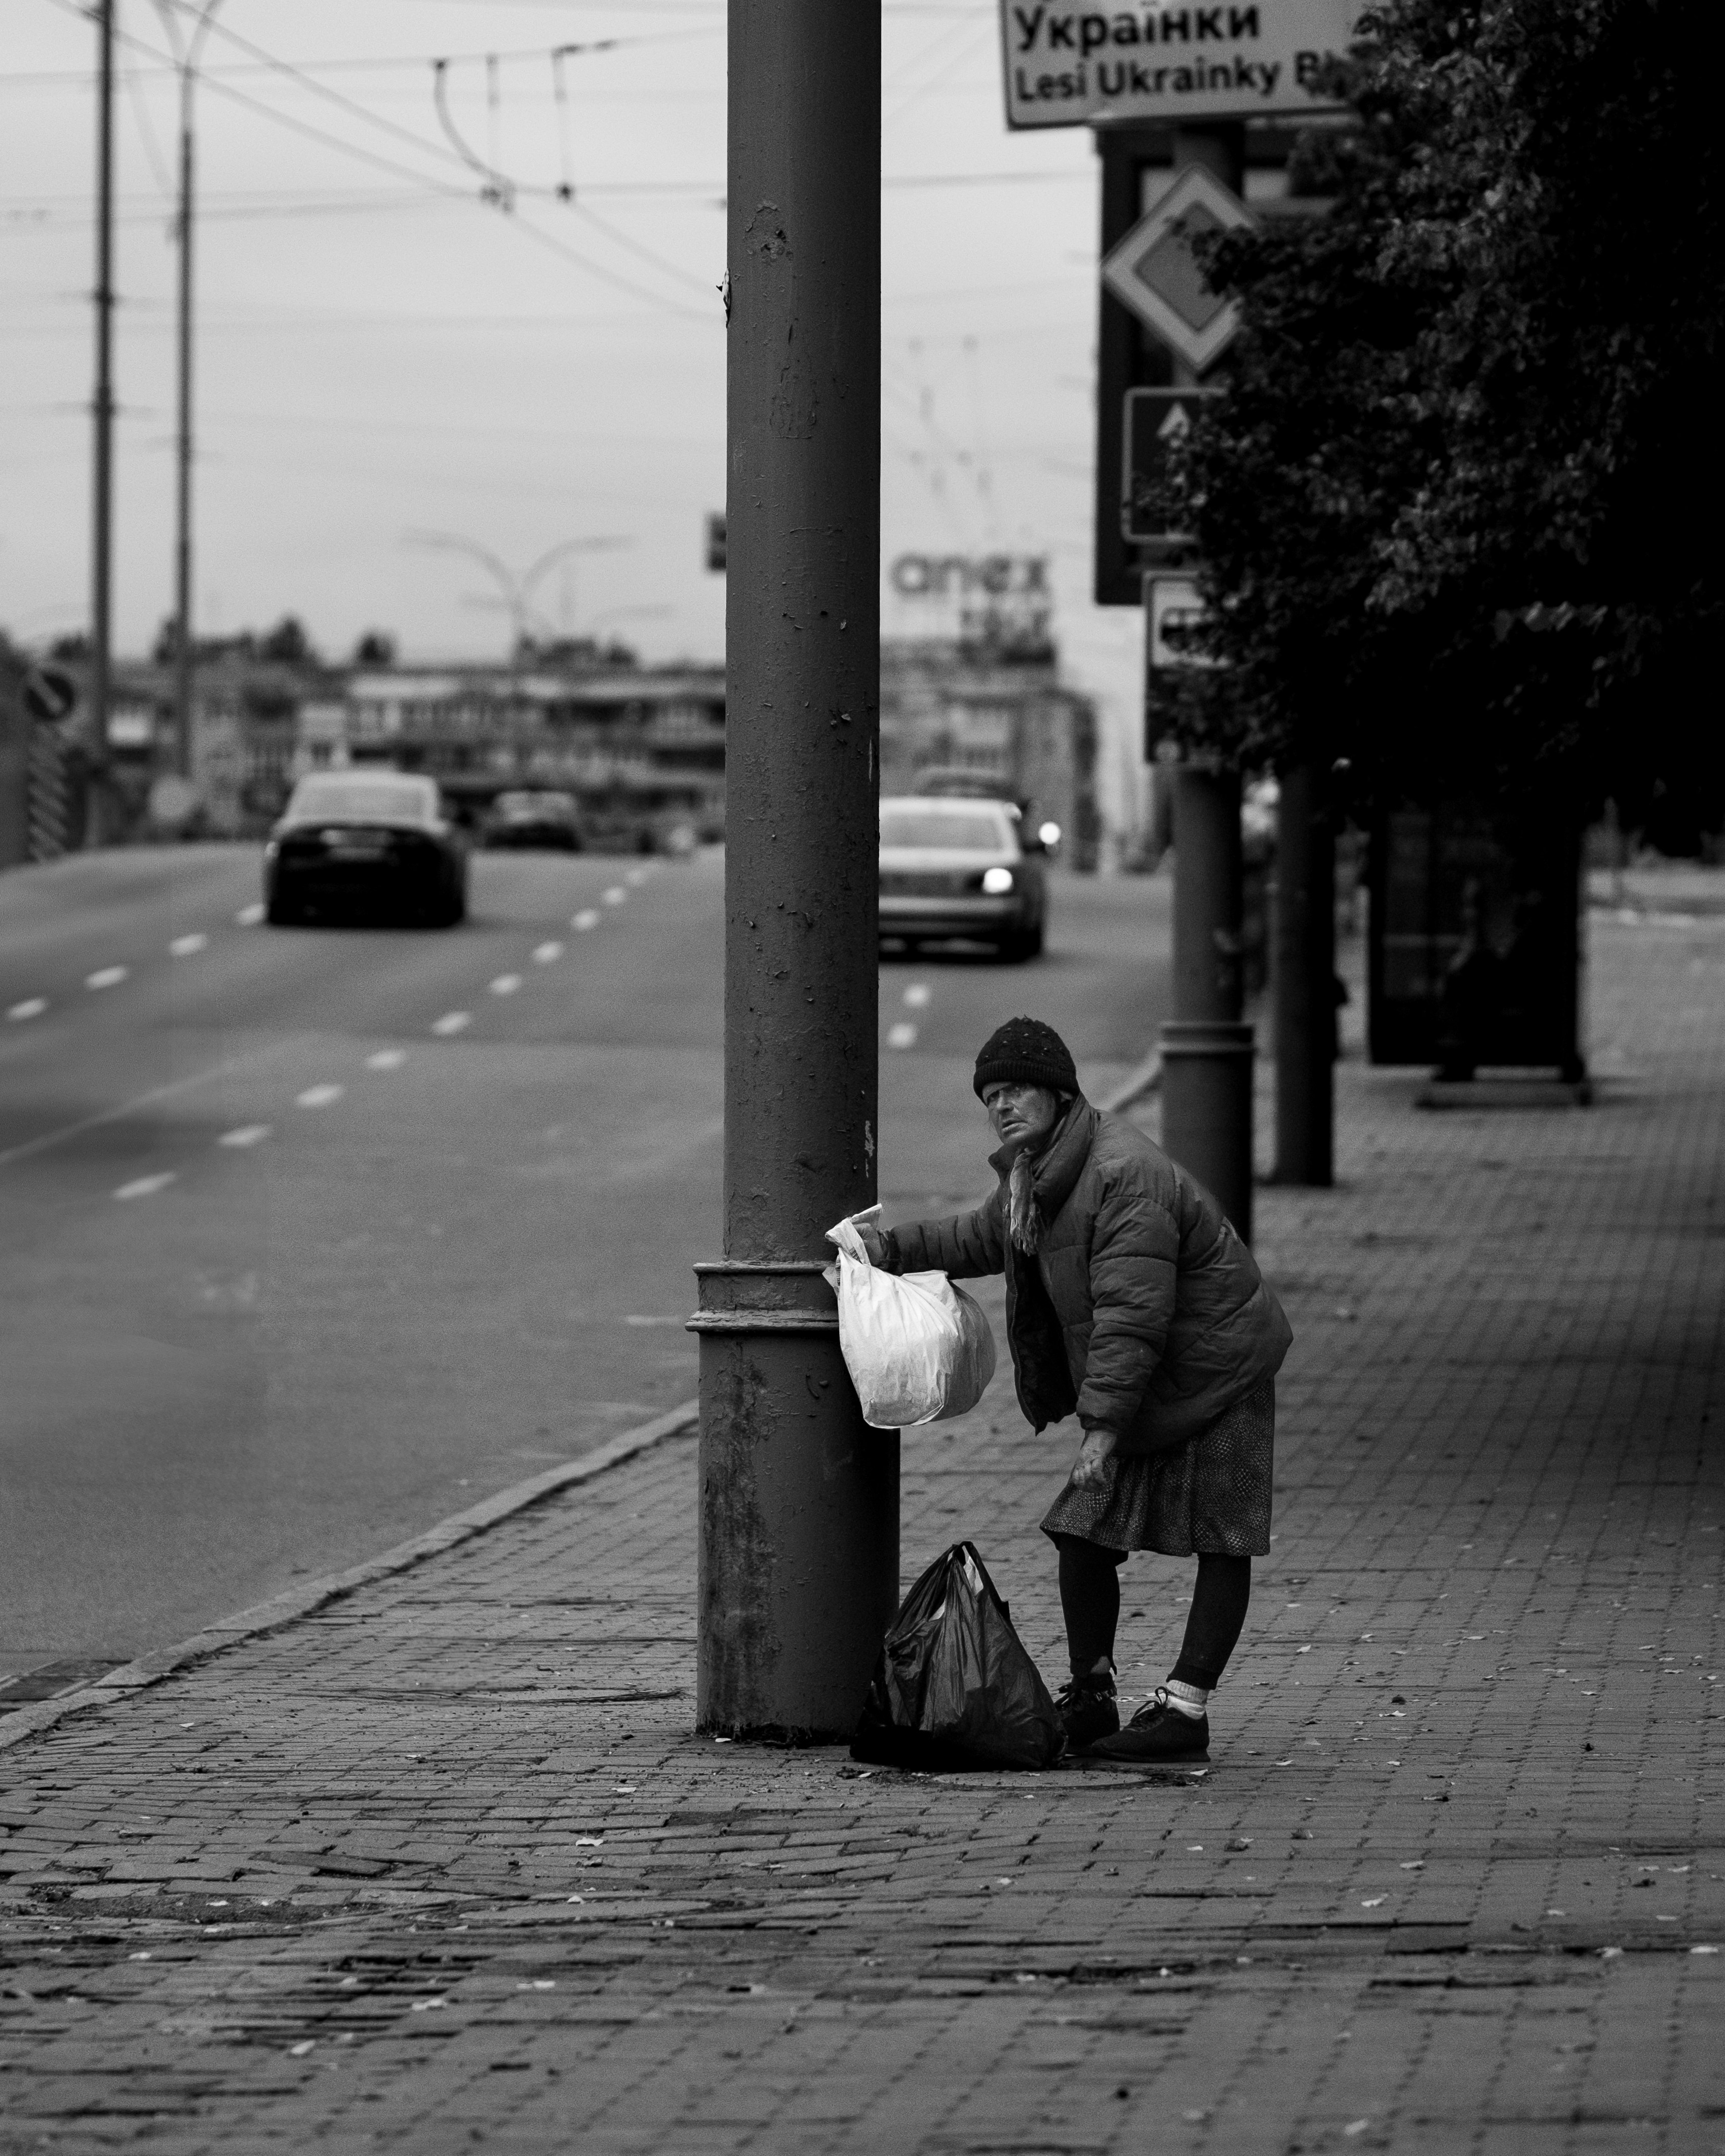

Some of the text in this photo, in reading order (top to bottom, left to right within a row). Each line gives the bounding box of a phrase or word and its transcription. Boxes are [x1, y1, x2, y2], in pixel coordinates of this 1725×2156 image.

[1013, 1, 1260, 57] Українки
[1016, 62, 1087, 101] Lesi
[1097, 55, 1281, 96] Ukrainky
